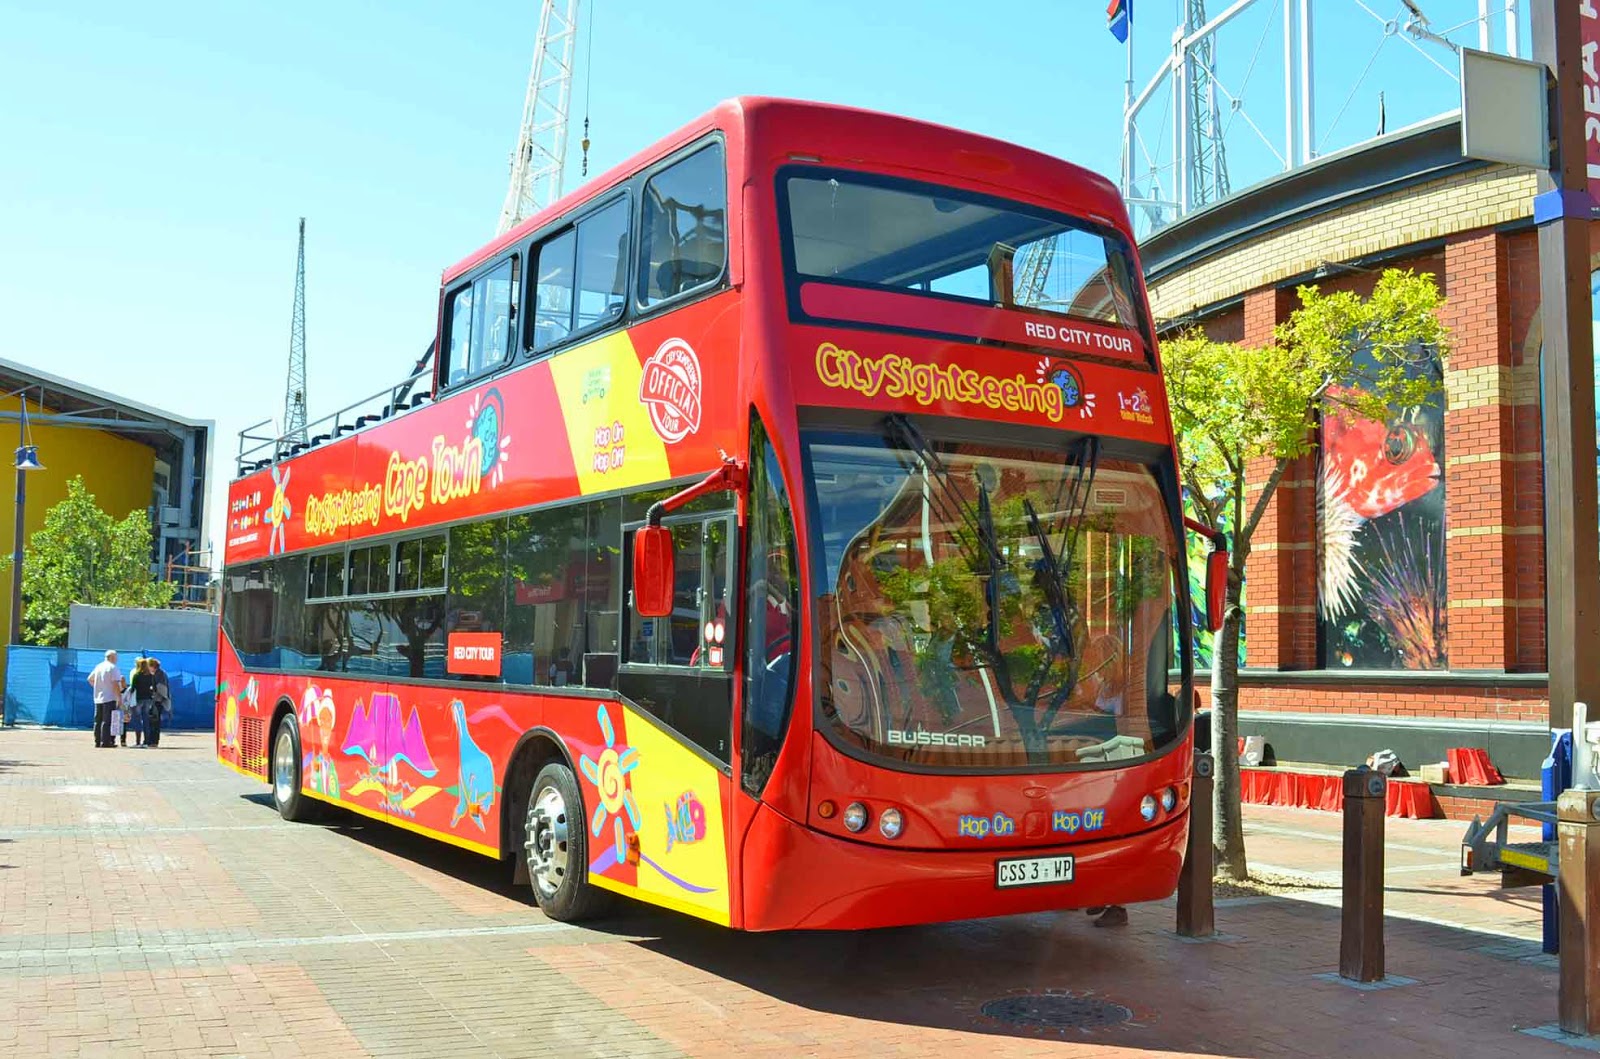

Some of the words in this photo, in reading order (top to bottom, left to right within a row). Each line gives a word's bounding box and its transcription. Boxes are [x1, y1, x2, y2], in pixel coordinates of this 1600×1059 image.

[1025, 322, 1056, 340] RED
[1059, 327, 1091, 346] CITY
[1093, 333, 1133, 353] TOUR
[648, 367, 696, 420] OFFICIAL
[1132, 394, 1140, 411] 2
[611, 420, 625, 443] On
[662, 412, 680, 432] TOUR
[384, 450, 429, 523] Cape
[430, 434, 482, 505] Town
[454, 646, 466, 660] RED
[466, 646, 478, 660] CITY
[478, 647, 495, 661] TOUR
[887, 729, 986, 747] BUSSCAR
[958, 814, 990, 839] Hop
[991, 811, 1015, 836] On
[1052, 809, 1080, 834] Hop
[1081, 808, 1105, 830] Off
[1000, 863, 1026, 882] CSS
[1030, 862, 1039, 880] 3
[1054, 860, 1071, 878] WP
